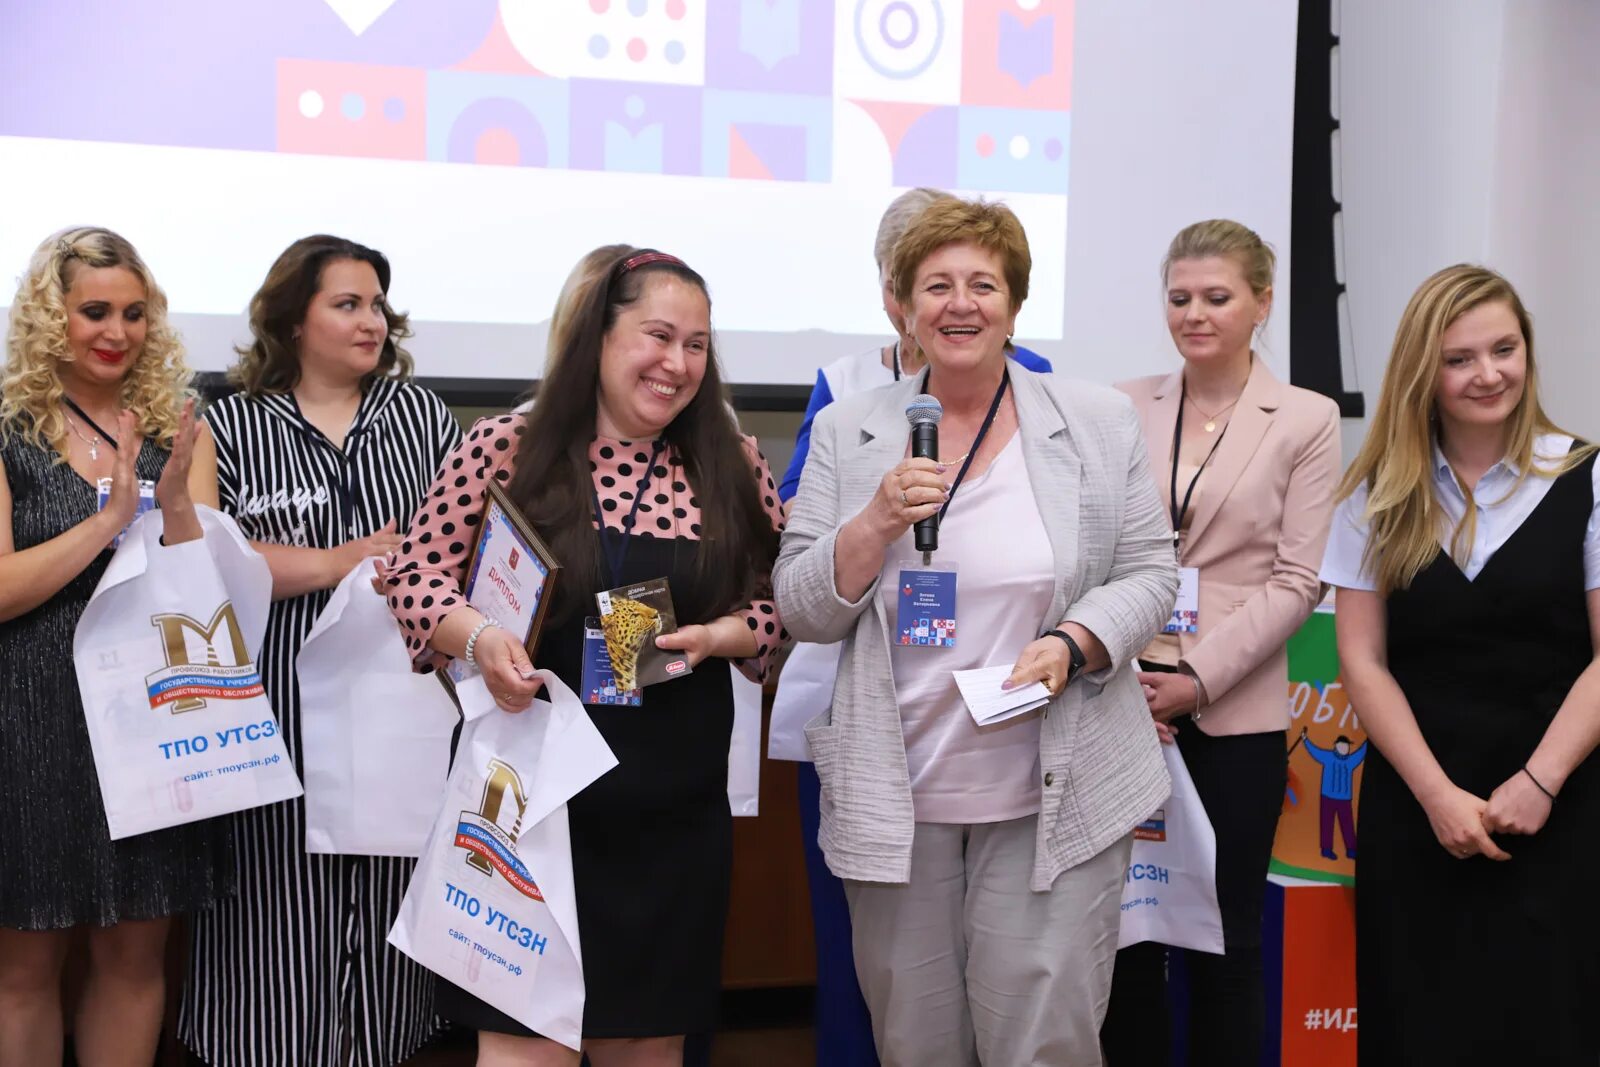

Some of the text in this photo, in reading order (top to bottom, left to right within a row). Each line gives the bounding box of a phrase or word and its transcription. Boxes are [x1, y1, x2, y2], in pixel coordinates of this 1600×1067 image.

[488, 566, 522, 615] ДИПЛОМ
[160, 677, 225, 690] ГОСУДАРСТВЕННЫХ
[170, 666, 211, 675] ПРОФСОЮЗ
[163, 687, 221, 701] ОБЩЕСТВЕННОГО
[158, 719, 278, 760] ТПО УТСЗ
[184, 753, 281, 782] сайт: тпоусзн.рф
[466, 826, 514, 866] ГОСУДАРСТВЕННЫХ
[480, 819, 509, 846] ПРОФСОЮЗ
[465, 838, 508, 873] ОБЩЕСТВЕННОГО
[1120, 897, 1159, 911] оусзн.рф
[445, 883, 547, 956] ТПО УТСЗН
[448, 928, 523, 976] сайт: тпоусзн.рф
[1304, 1008, 1358, 1032] #ИД
